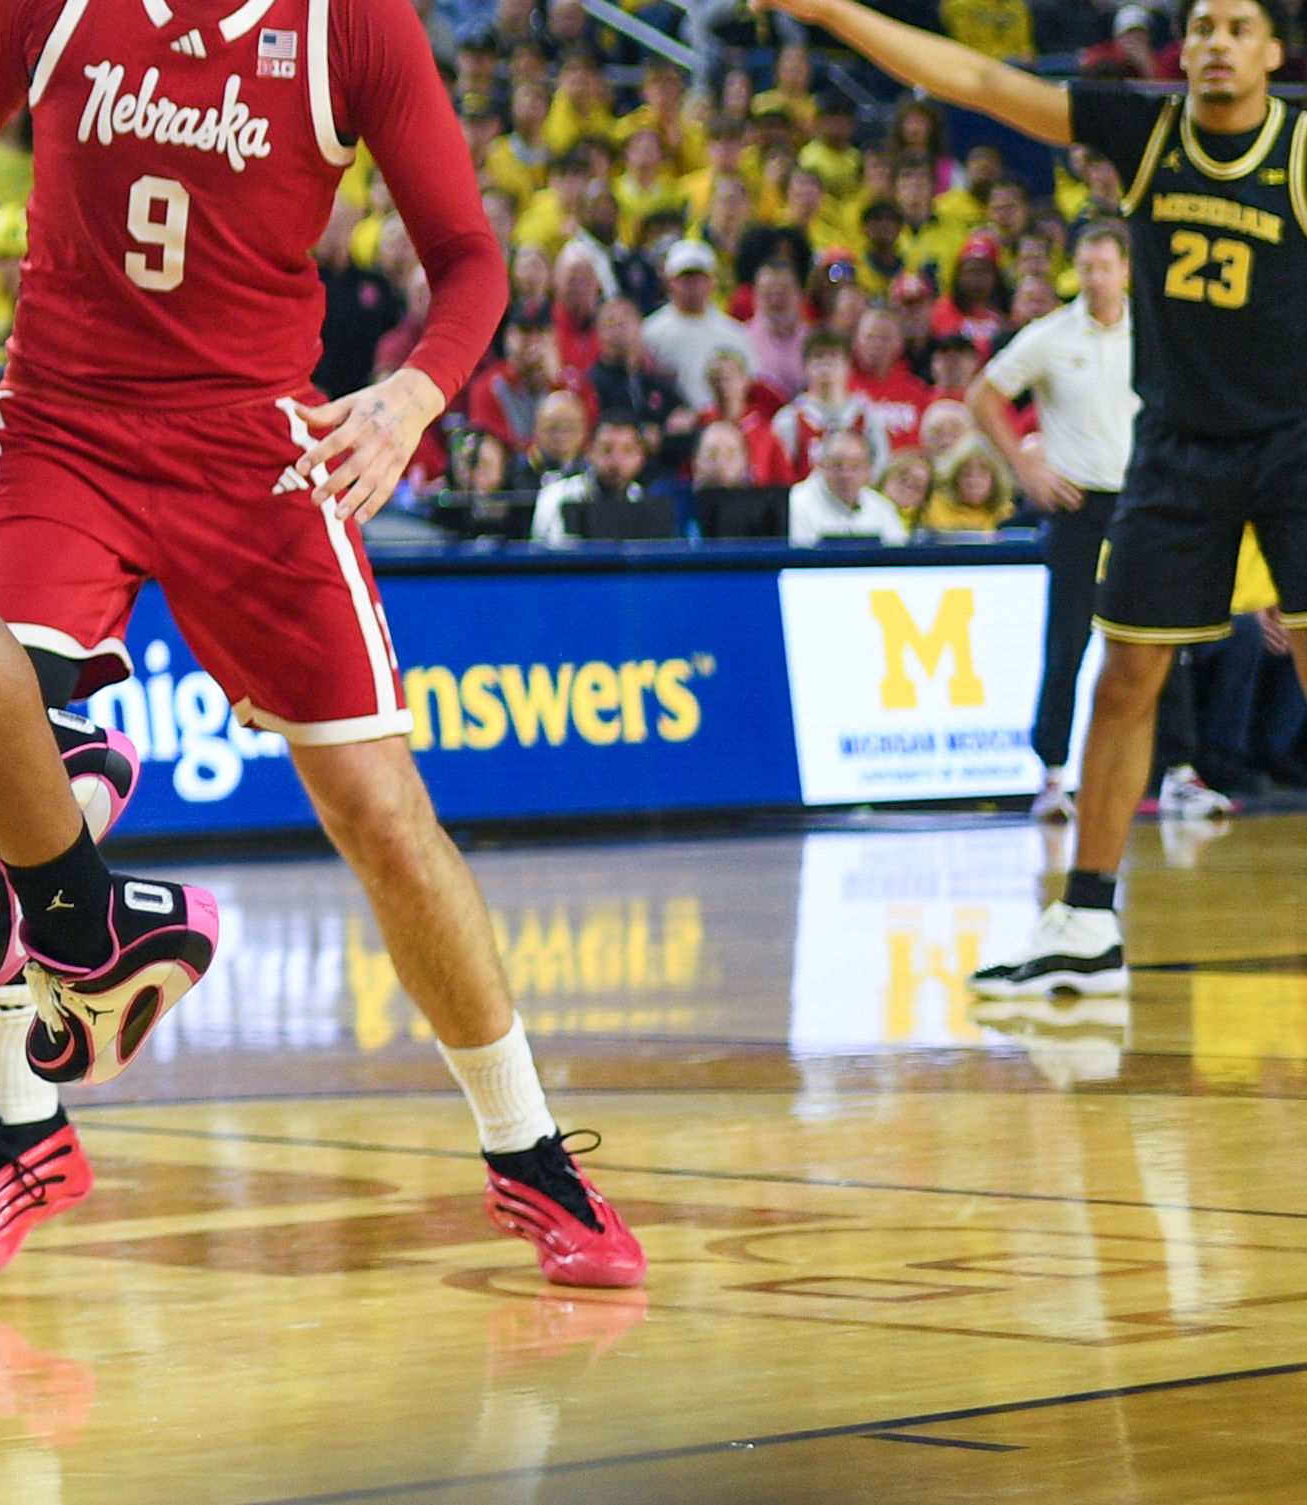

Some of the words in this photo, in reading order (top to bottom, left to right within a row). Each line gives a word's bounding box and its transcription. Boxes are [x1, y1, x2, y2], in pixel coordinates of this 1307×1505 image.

[78, 60, 271, 172] Nebraska
[124, 174, 190, 292] 9
[1164, 229, 1252, 310] 23
[404, 657, 701, 751] nswers
[869, 587, 986, 710] M
